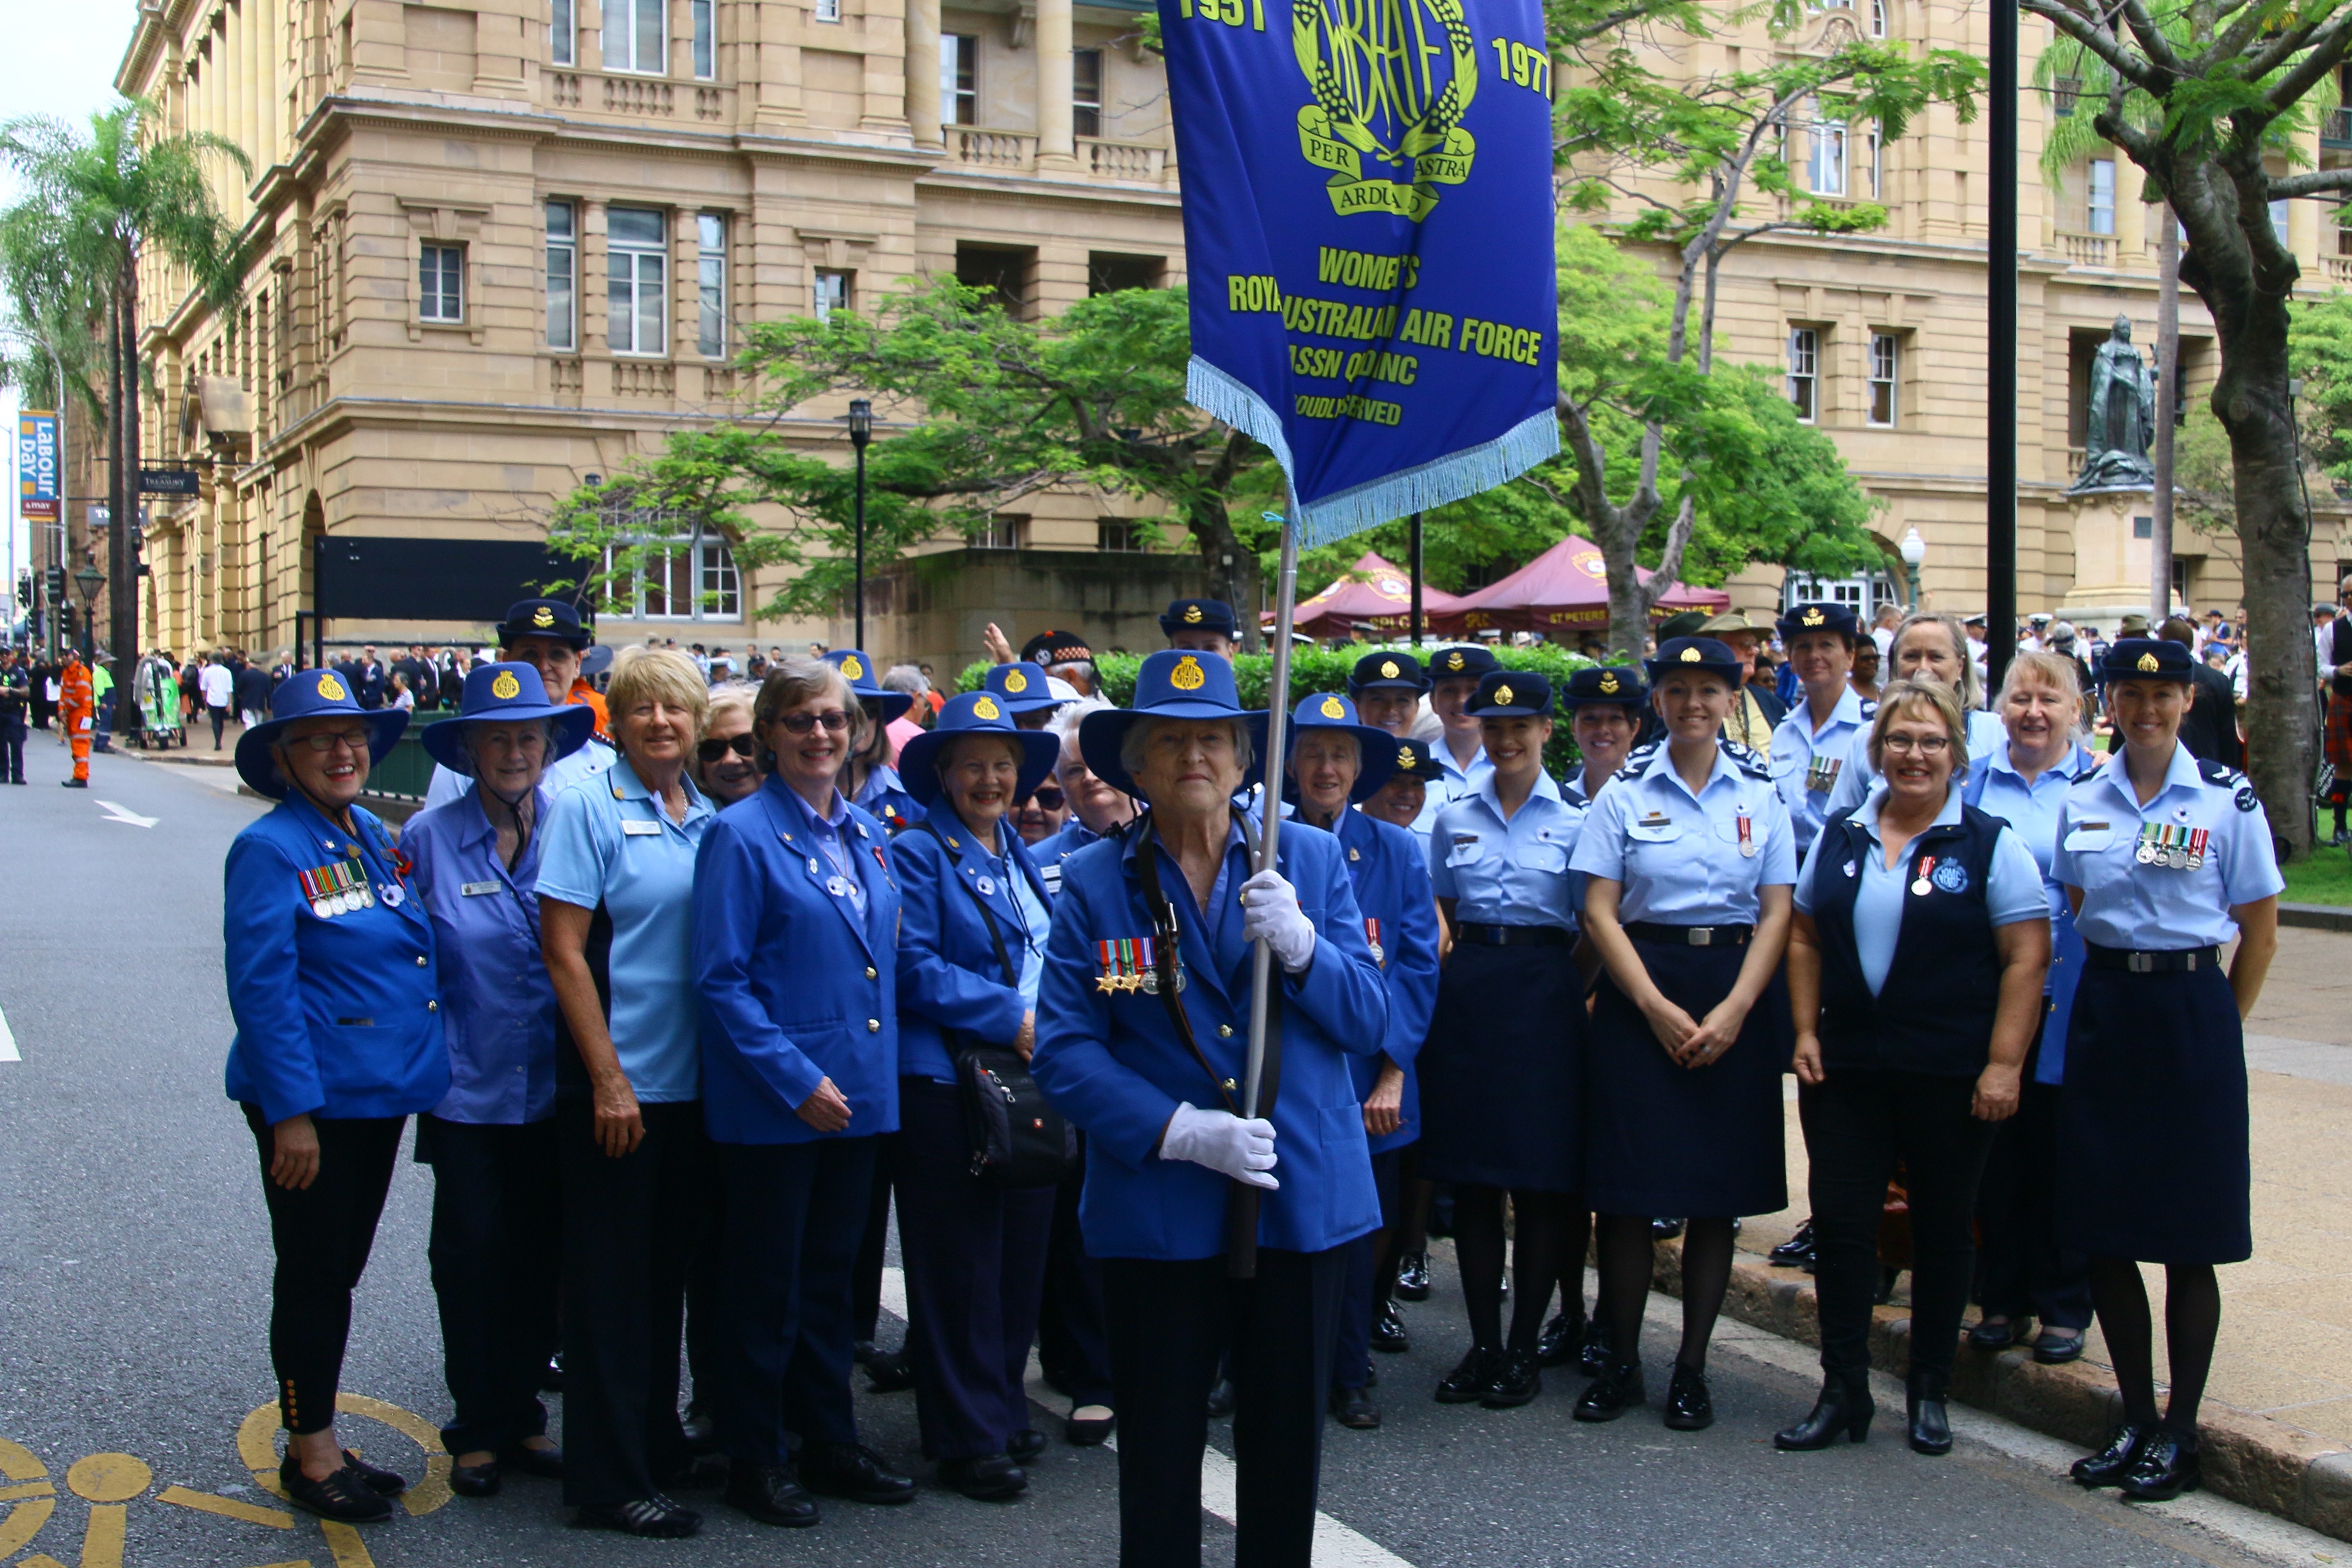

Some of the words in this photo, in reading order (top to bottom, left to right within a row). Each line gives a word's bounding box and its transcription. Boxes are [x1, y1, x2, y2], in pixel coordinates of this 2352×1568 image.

[1310, 139, 1350, 168] PER
[1415, 158, 1467, 178] ASTRA
[1340, 186, 1401, 209] ARDUA
[1408, 195, 1421, 213] D
[1318, 246, 1420, 290] WOME'S
[1227, 275, 1283, 312] ROYA
[1282, 295, 1399, 339] USTRAL
[1399, 308, 1453, 348] AIR
[1459, 318, 1542, 366] FORCE
[1344, 349, 1376, 383] QD
[1295, 394, 1341, 419] OUDL
[1565, 610, 1606, 622] PETERS
